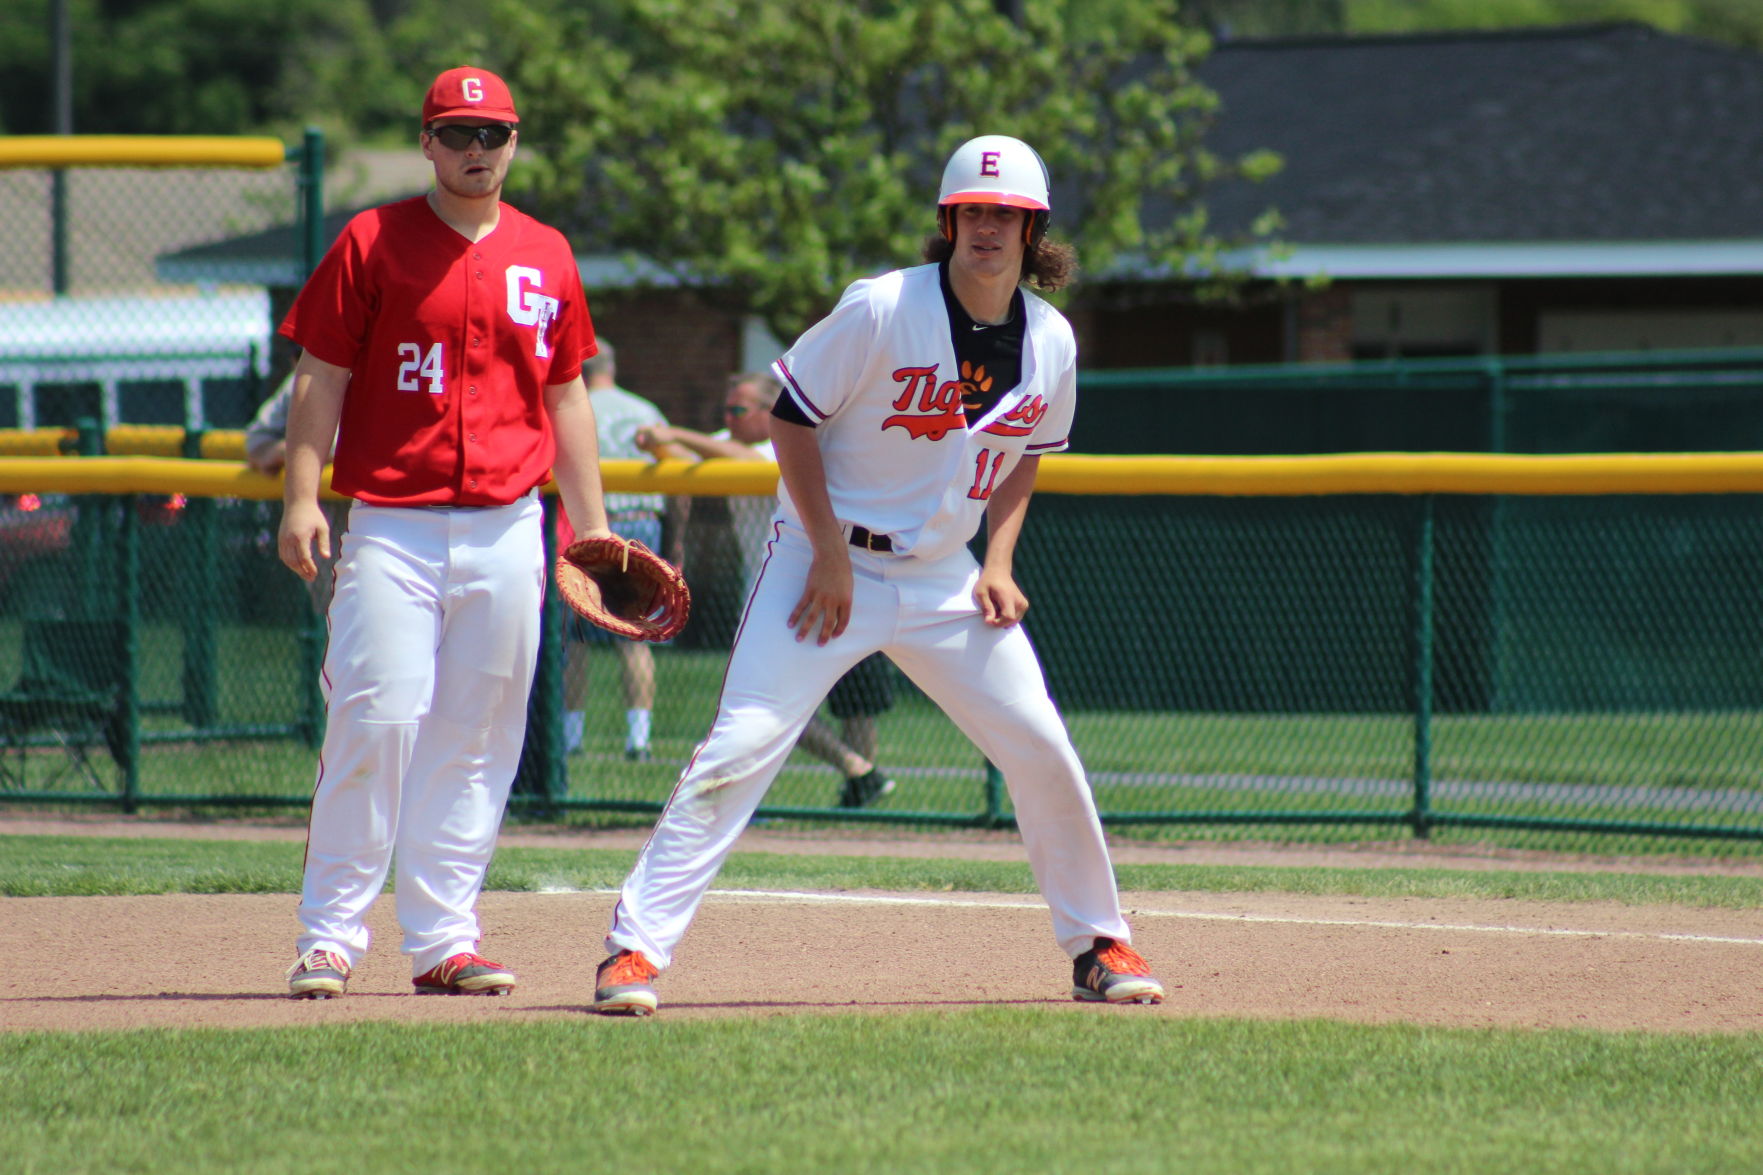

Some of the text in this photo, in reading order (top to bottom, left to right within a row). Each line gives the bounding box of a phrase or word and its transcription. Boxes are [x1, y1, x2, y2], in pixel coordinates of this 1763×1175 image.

[461, 77, 484, 102] G
[980, 151, 1001, 177] E
[397, 342, 445, 394] 24
[882, 363, 1049, 438] Tigs
[967, 447, 1005, 501] 11
